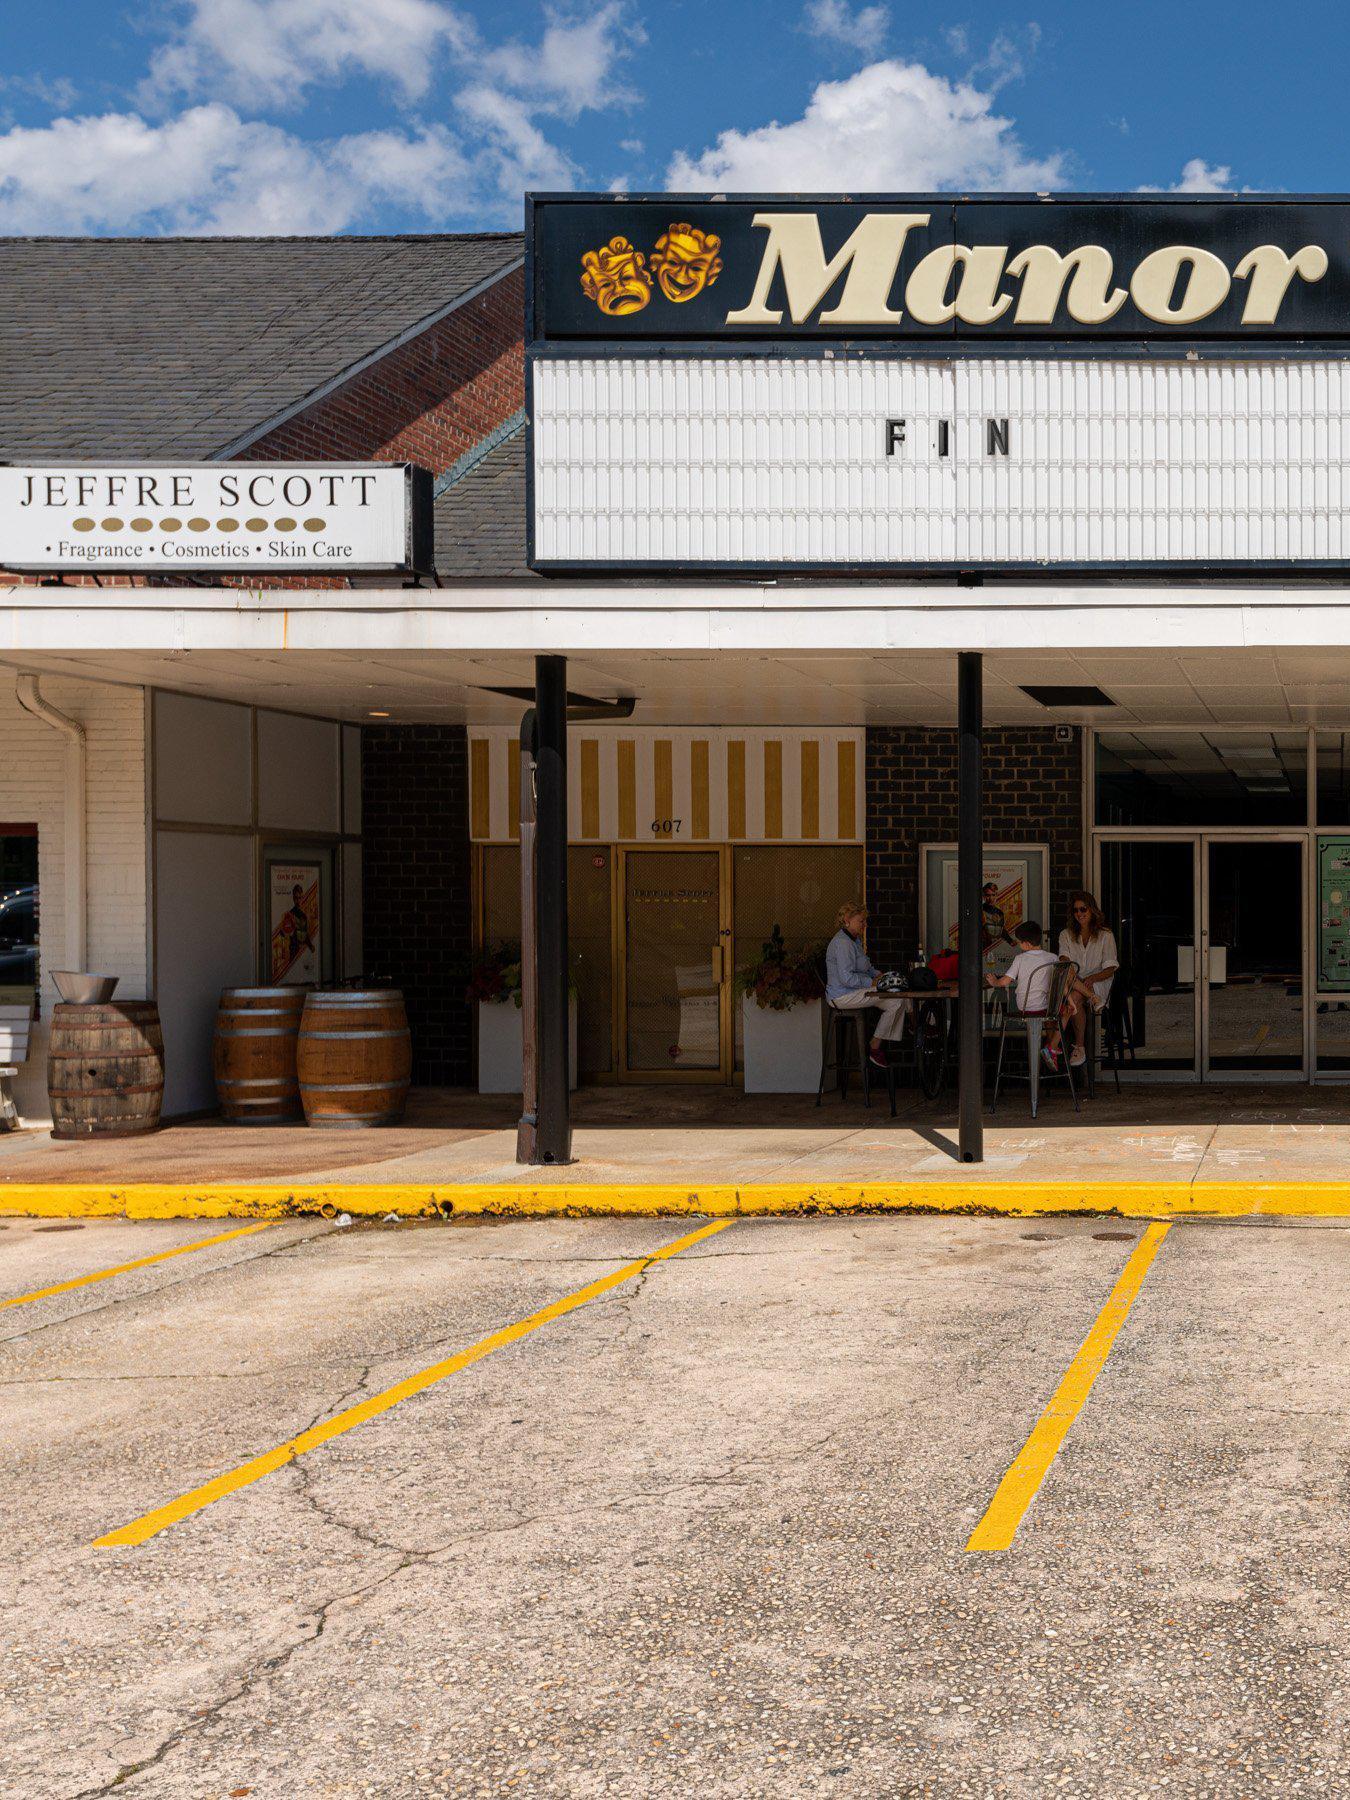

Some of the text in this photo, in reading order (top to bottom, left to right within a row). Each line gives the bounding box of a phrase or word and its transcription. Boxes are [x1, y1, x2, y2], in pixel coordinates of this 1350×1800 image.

[725, 212, 1329, 325] Manor
[20, 475, 377, 507] JEFFRE SCOTT
[58, 541, 352, 559] Fragrance Cosmetics Skin Care
[651, 818, 682, 833] 607
